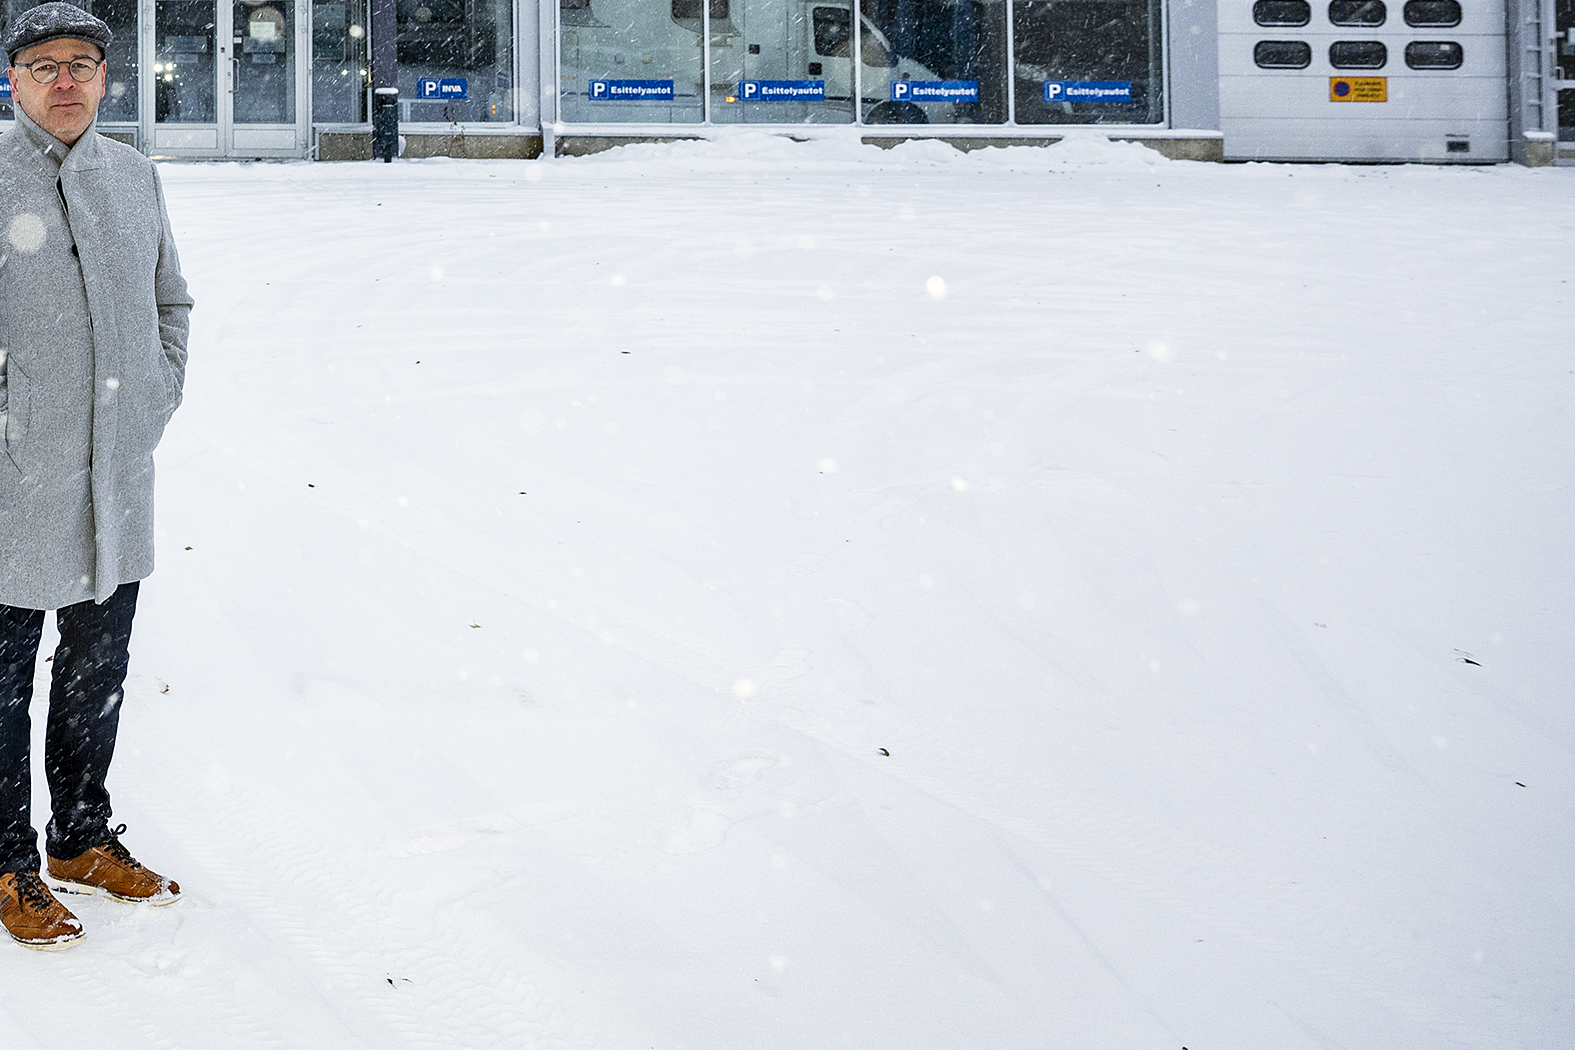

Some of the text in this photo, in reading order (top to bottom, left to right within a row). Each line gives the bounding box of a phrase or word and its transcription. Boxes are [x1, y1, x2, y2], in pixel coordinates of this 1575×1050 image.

[425, 81, 436, 96] P
[593, 82, 671, 97] P Esittelyautot
[744, 83, 755, 98] P
[895, 83, 975, 99] P Esittelyautot
[1048, 83, 1128, 99] P Esittelyautot
